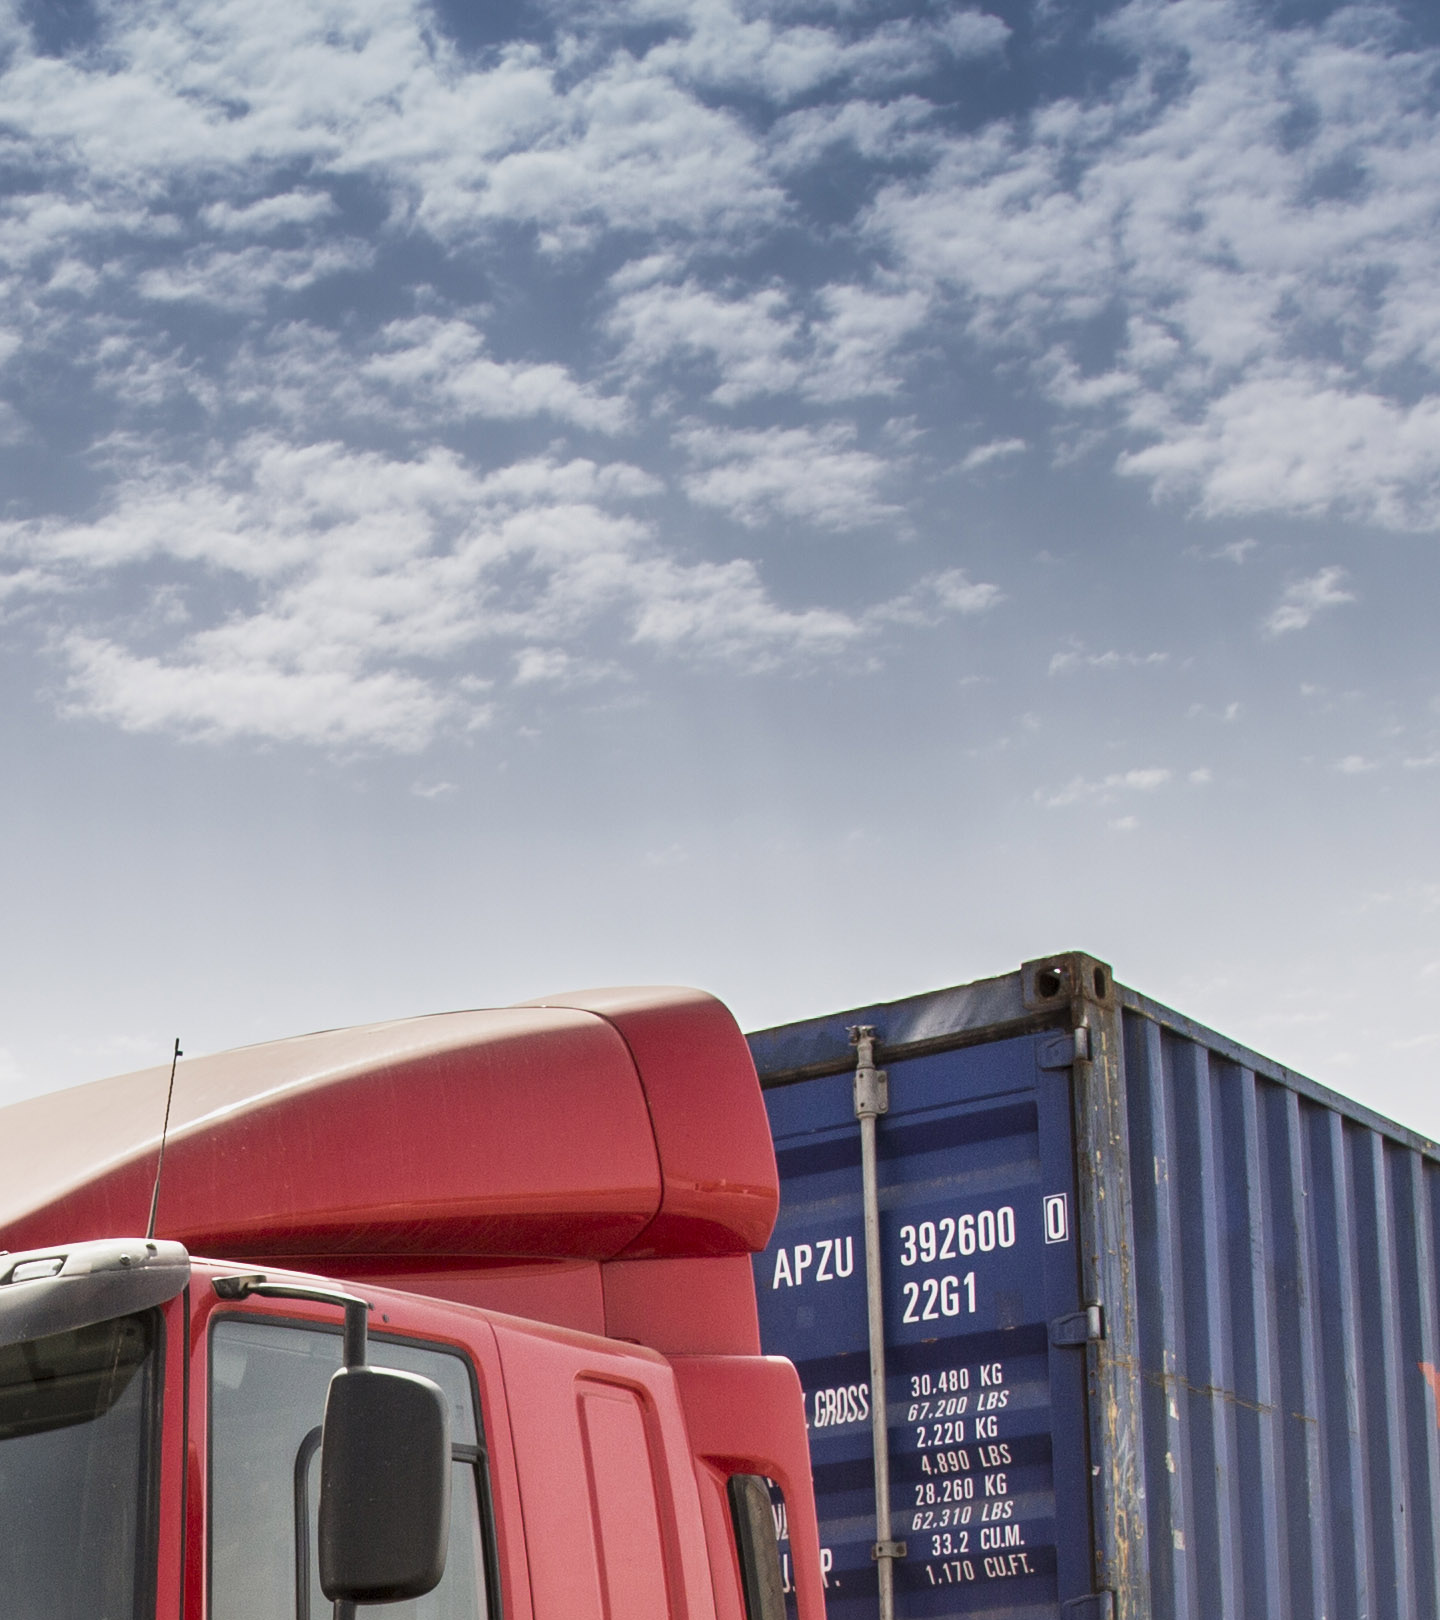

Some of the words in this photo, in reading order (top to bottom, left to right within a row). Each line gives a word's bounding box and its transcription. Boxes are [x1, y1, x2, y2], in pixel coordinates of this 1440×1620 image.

[773, 1236, 854, 1289] APZU
[900, 1206, 1016, 1266] 392600
[902, 1272, 976, 1324] 22G1
[980, 1363, 1003, 1387] KG
[814, 1384, 869, 1428] GROSS
[977, 1390, 1010, 1411] LBS
[975, 1416, 998, 1439] KG
[979, 1444, 1011, 1467] LBS
[985, 1473, 1007, 1496] KG
[981, 1501, 1013, 1521] LBS
[932, 1531, 969, 1556] 33.2
[980, 1525, 1025, 1550] CU.M.
[984, 1553, 1035, 1578] CU.FT.
